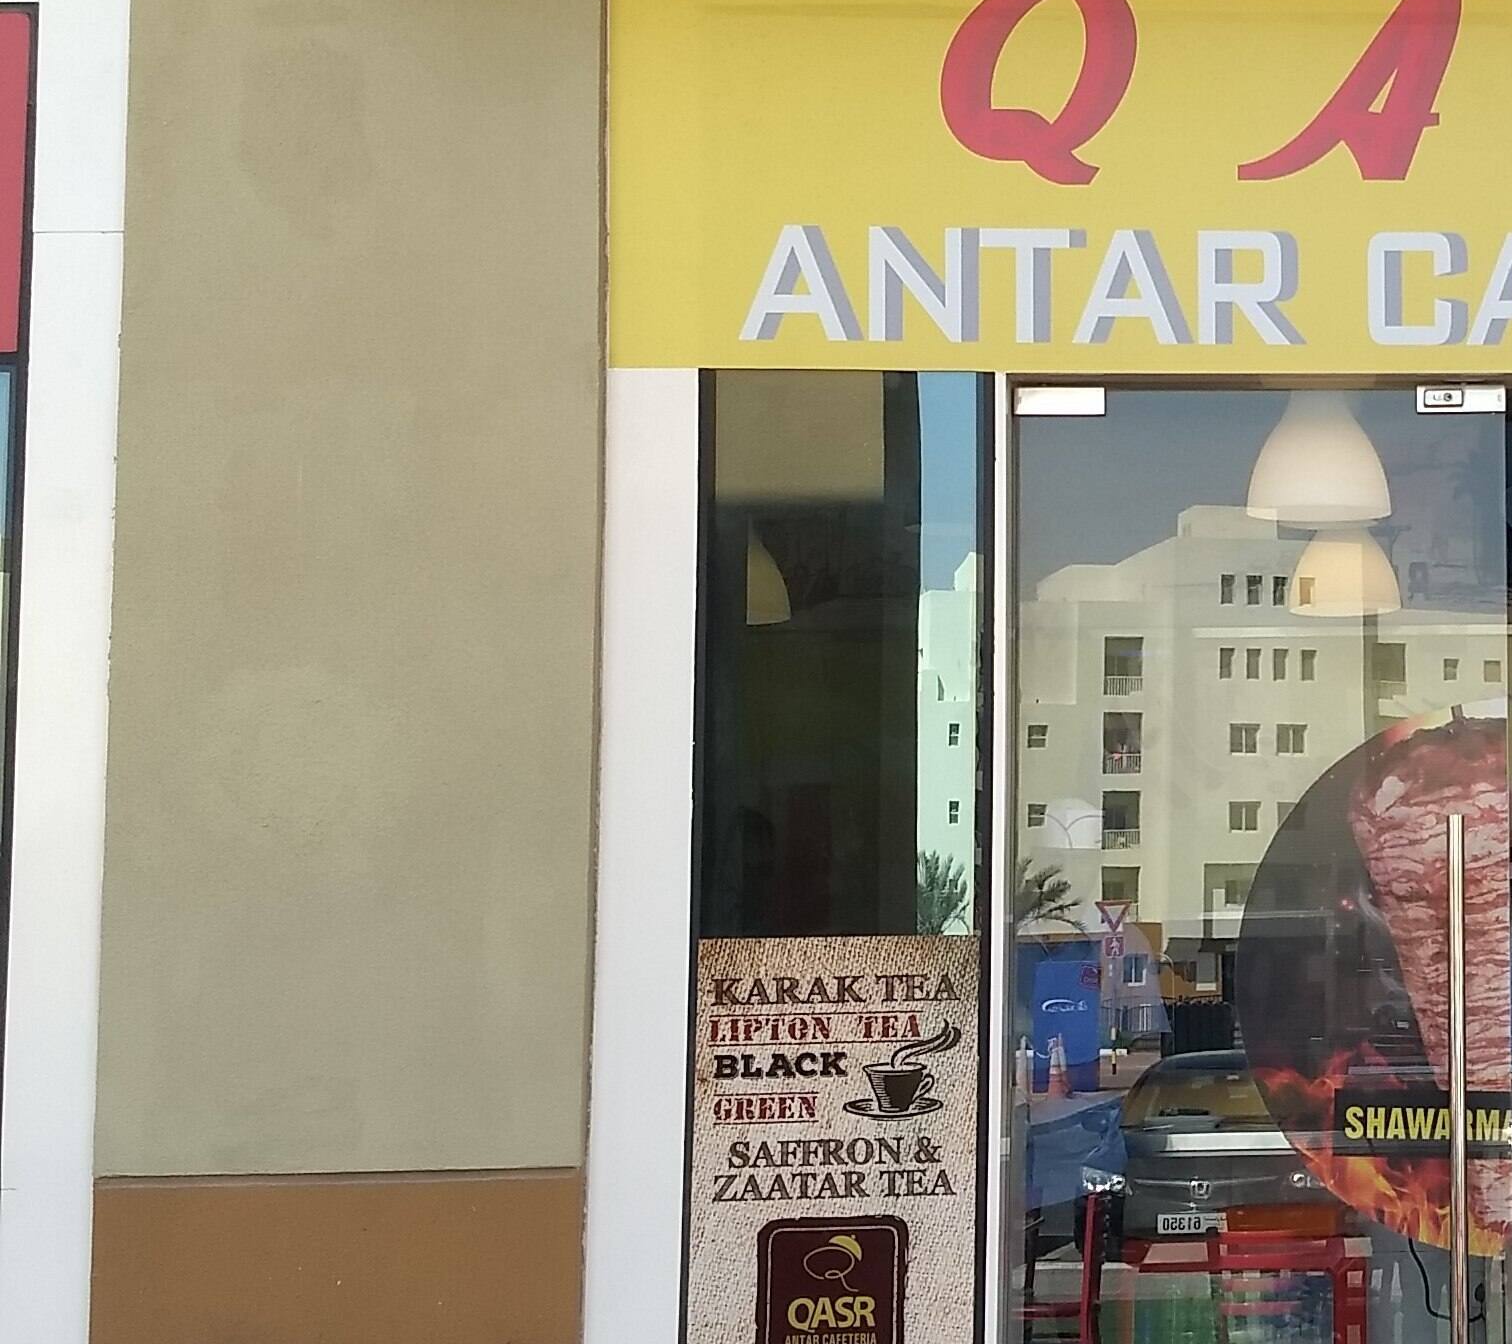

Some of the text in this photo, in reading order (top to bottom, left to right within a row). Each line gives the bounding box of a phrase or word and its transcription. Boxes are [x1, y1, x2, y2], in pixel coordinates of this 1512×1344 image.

[739, 224, 1307, 345] ANTAR
[711, 974, 961, 1006] KARAK TEA
[708, 1013, 922, 1043] LIPTON TEA
[713, 1052, 848, 1079] BLACK
[713, 1095, 818, 1121] GREEN
[728, 1135, 943, 1169] SAFFRON &
[712, 1168, 957, 1203] ZAATAR TEA
[787, 1296, 876, 1333] QASR
